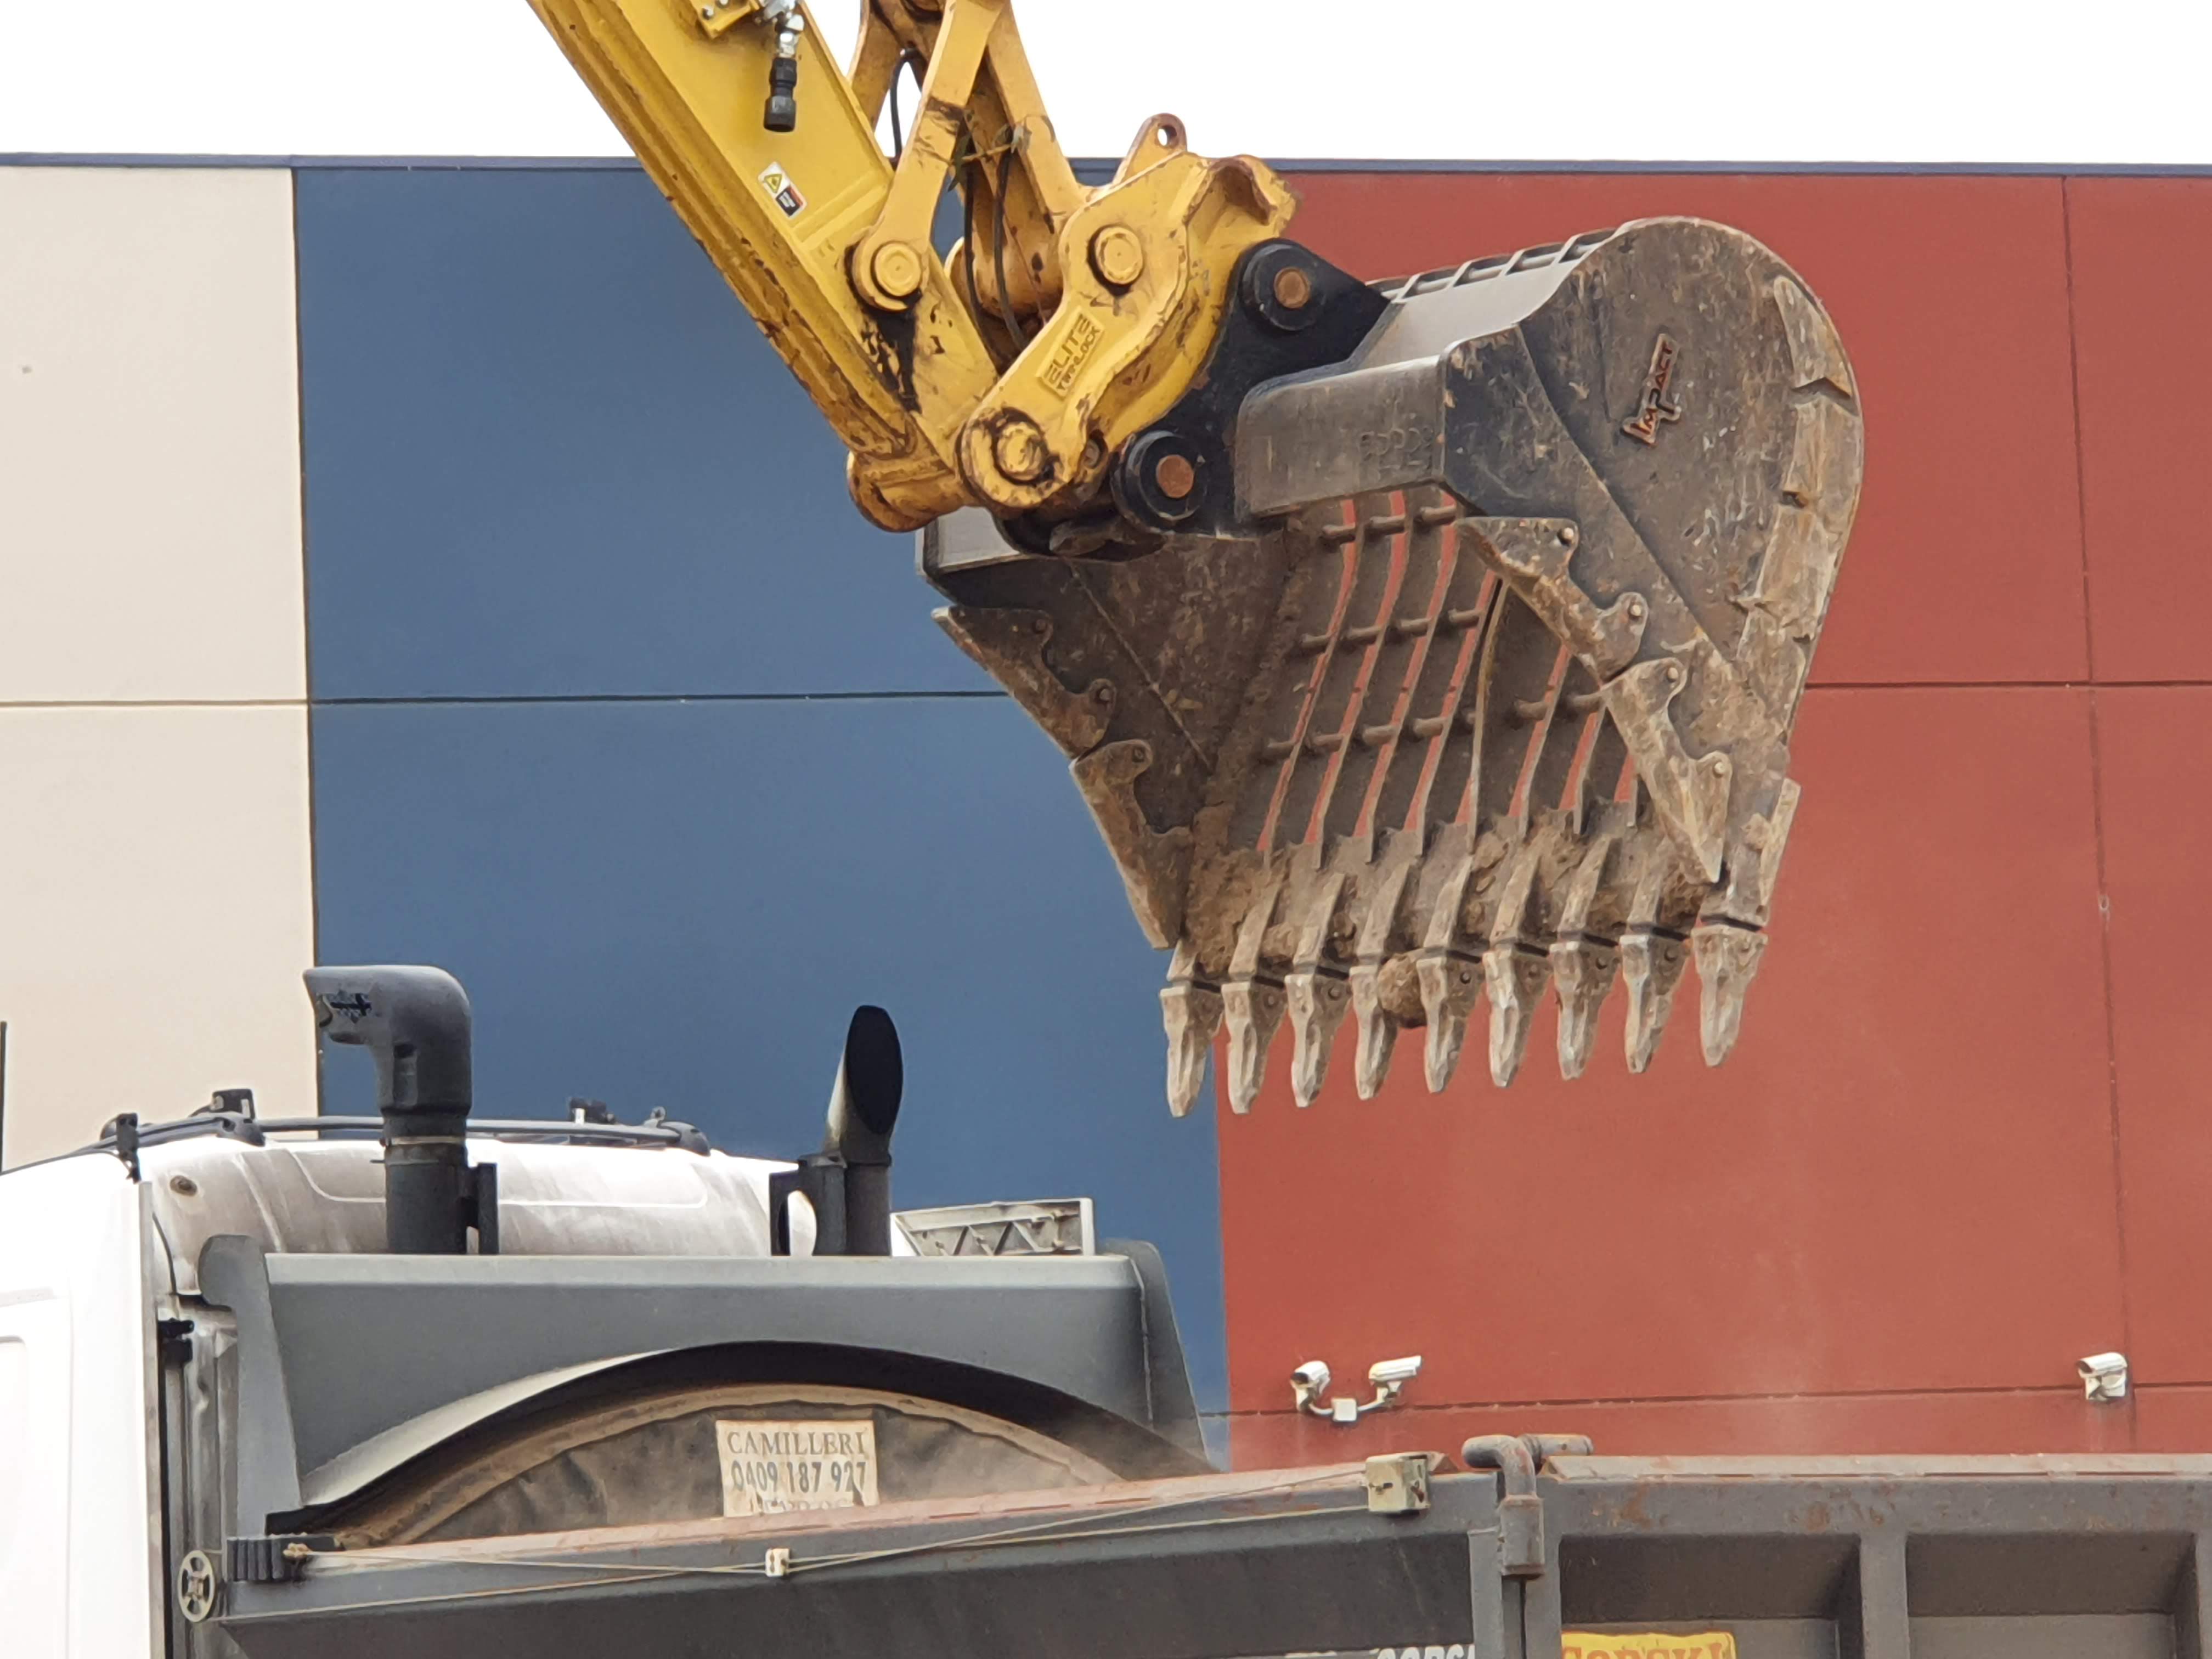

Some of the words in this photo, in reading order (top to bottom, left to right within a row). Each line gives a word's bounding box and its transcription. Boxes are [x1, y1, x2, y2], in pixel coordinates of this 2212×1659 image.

[1044, 313, 1090, 385] ELITE
[1629, 339, 1677, 436] IMPACT
[727, 1430, 866, 1456] CAMILLERI
[731, 1459, 778, 1492] 0409
[786, 1460, 822, 1493] 187
[831, 1460, 866, 1493] 927
